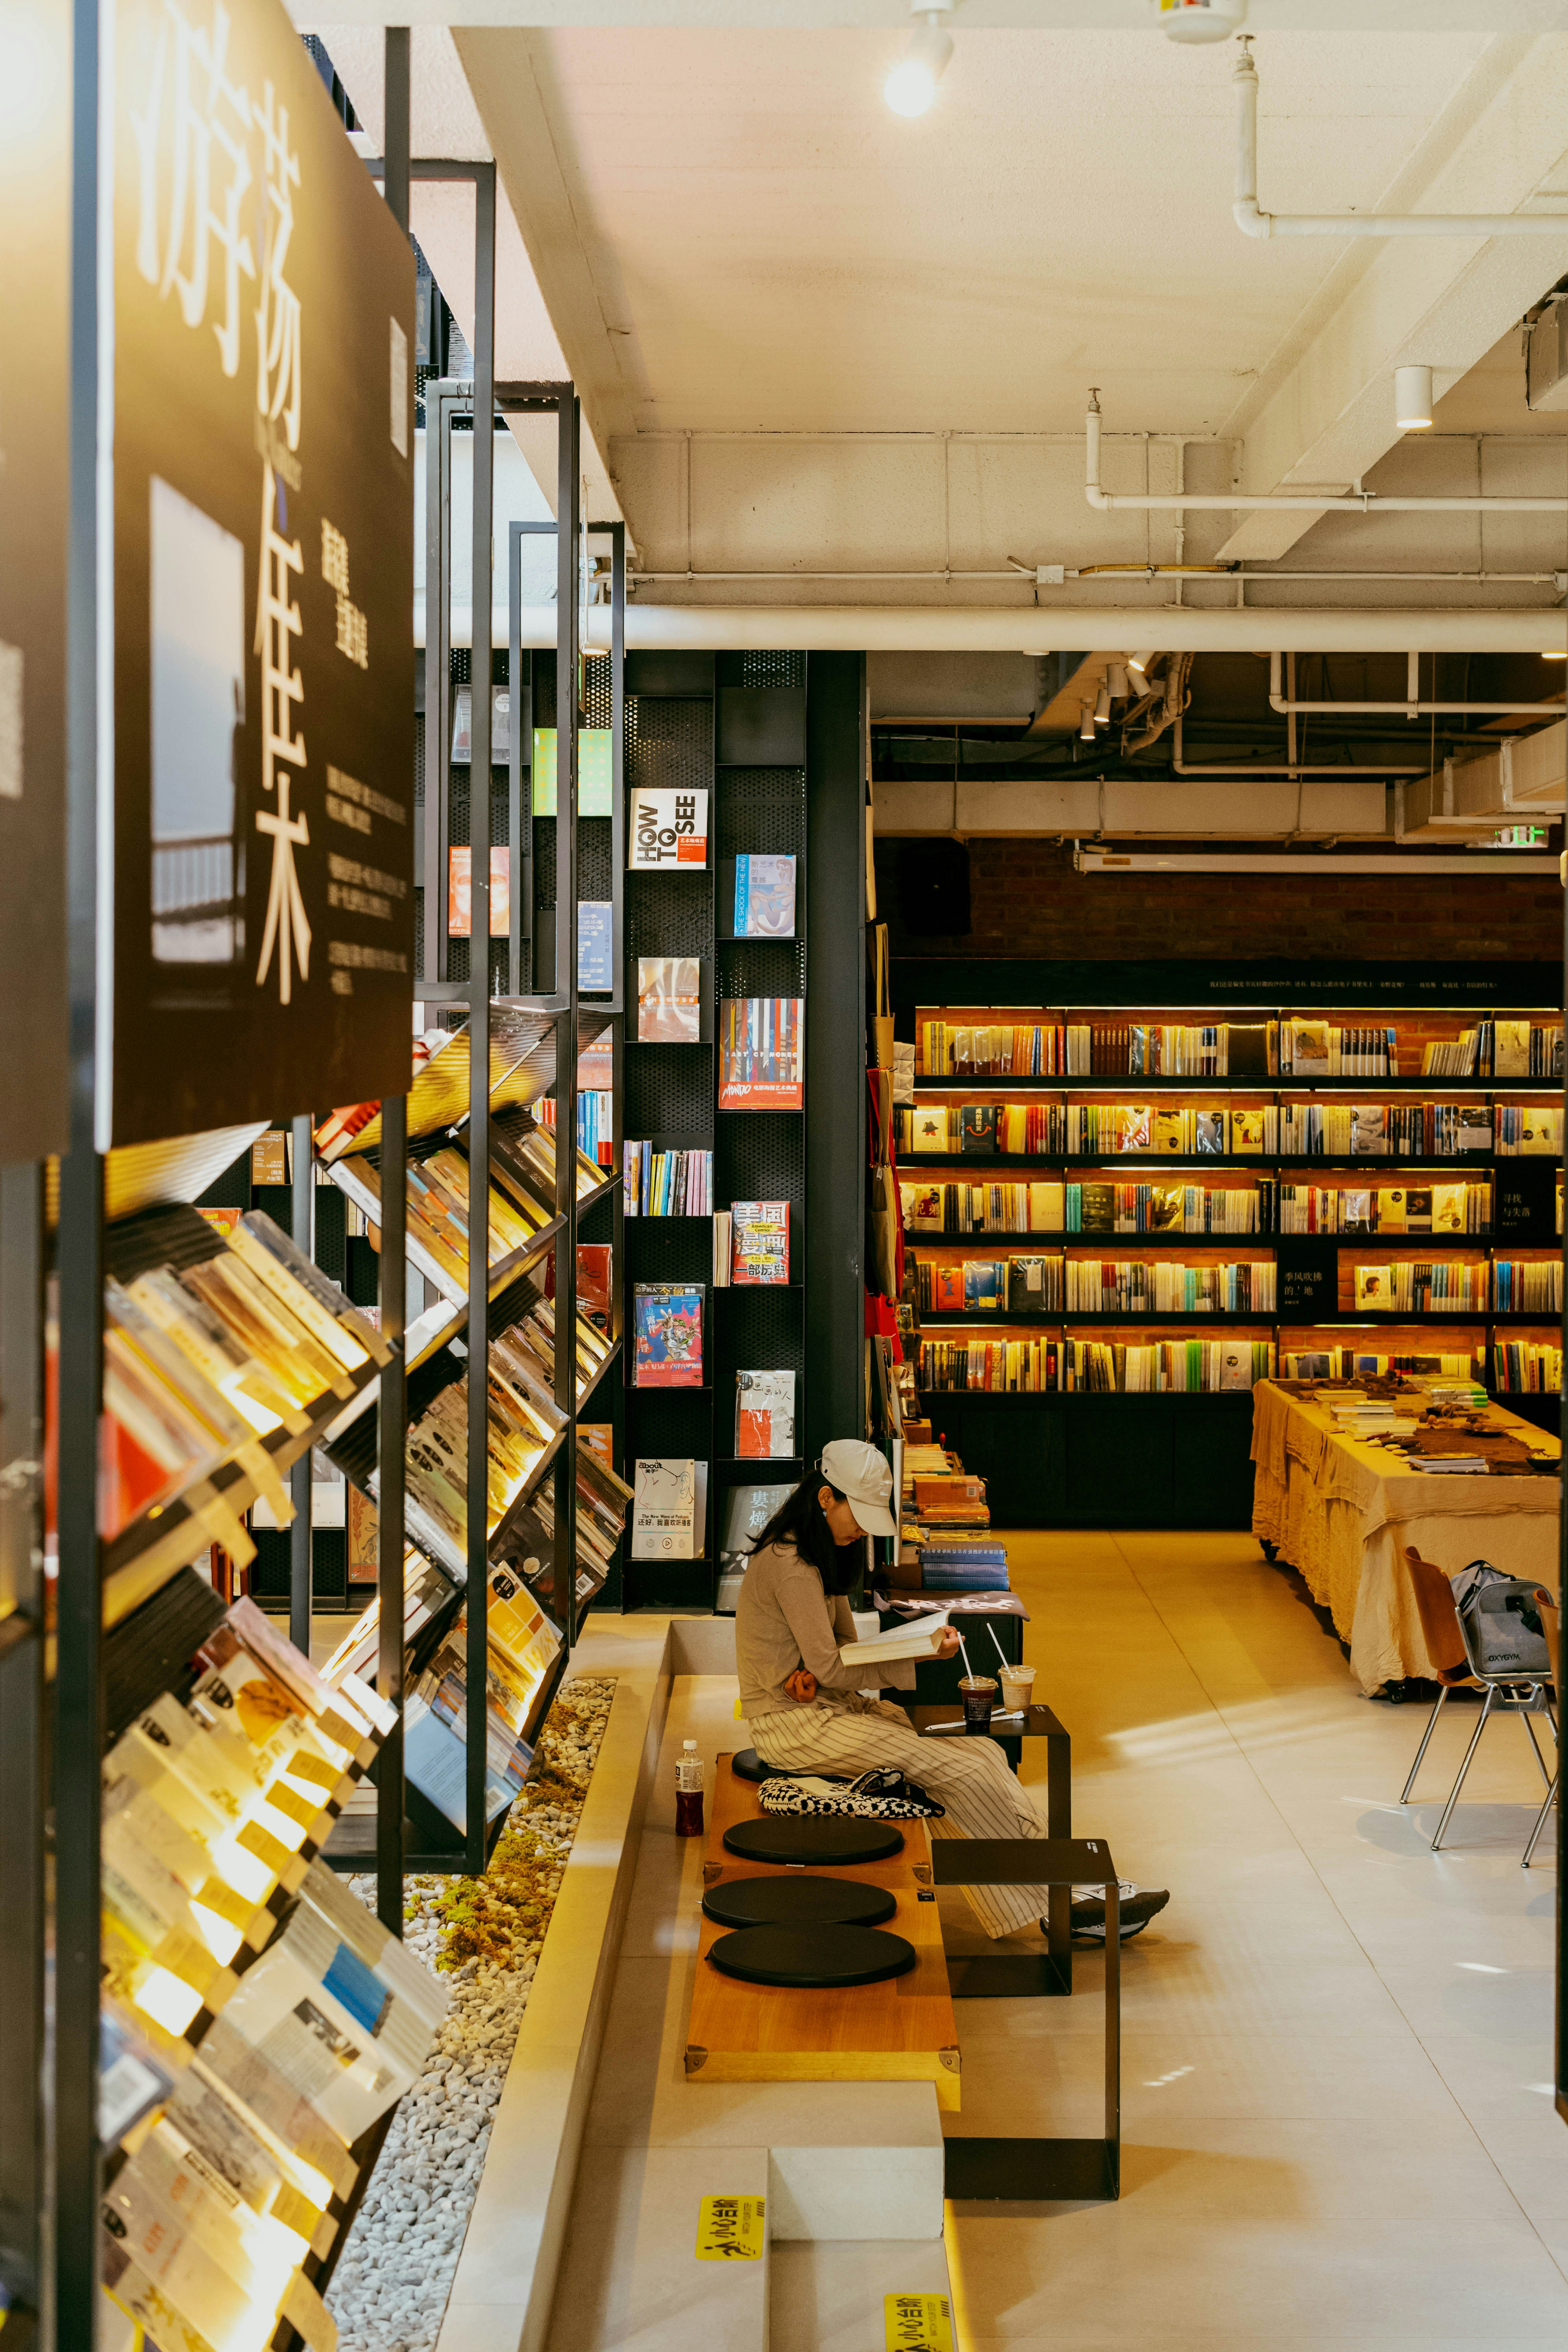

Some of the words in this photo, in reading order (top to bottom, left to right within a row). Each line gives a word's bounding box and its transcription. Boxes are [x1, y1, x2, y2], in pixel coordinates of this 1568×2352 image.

[675, 796, 695, 835] SEE
[637, 804, 658, 862] HOW
[657, 828, 677, 862] TO
[721, 1084, 752, 1100] MONDO
[1503, 1193, 1522, 1204] 寻找
[737, 1203, 786, 1228] 美国
[736, 1230, 786, 1255] 漫画
[735, 1264, 786, 1276] 一部历史
[1284, 1272, 1322, 1281] 季风吹拂
[1488, 1653, 1521, 1662] OXYGYM
[709, 2199, 739, 2238] 小心台阶
[895, 2297, 925, 2340] 小心台阶
